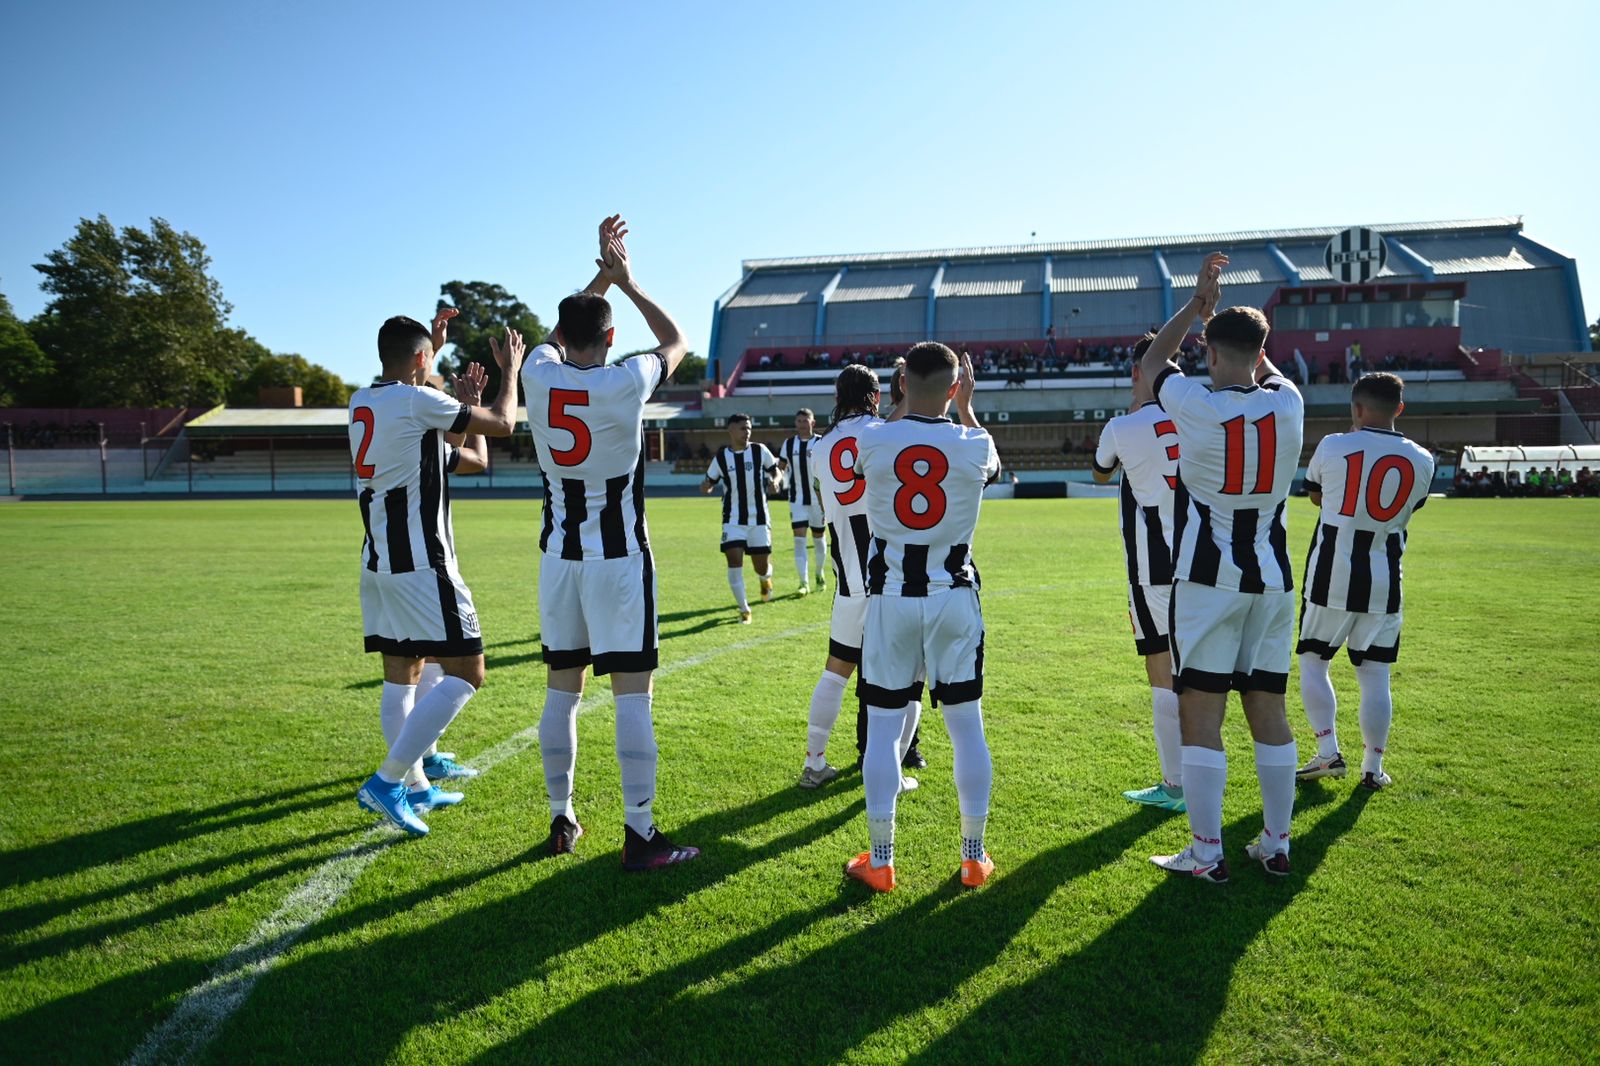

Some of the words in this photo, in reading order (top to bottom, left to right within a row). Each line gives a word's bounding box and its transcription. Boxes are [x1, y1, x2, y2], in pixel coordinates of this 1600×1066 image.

[1334, 250, 1378, 263] BELL
[352, 406, 376, 479] 2
[548, 388, 592, 467] 5
[714, 416, 780, 428] BLL
[1153, 420, 1180, 491] 3
[1218, 411, 1277, 496] 11
[829, 437, 868, 506] 9
[893, 443, 949, 530] 8
[1337, 450, 1416, 522] 10
